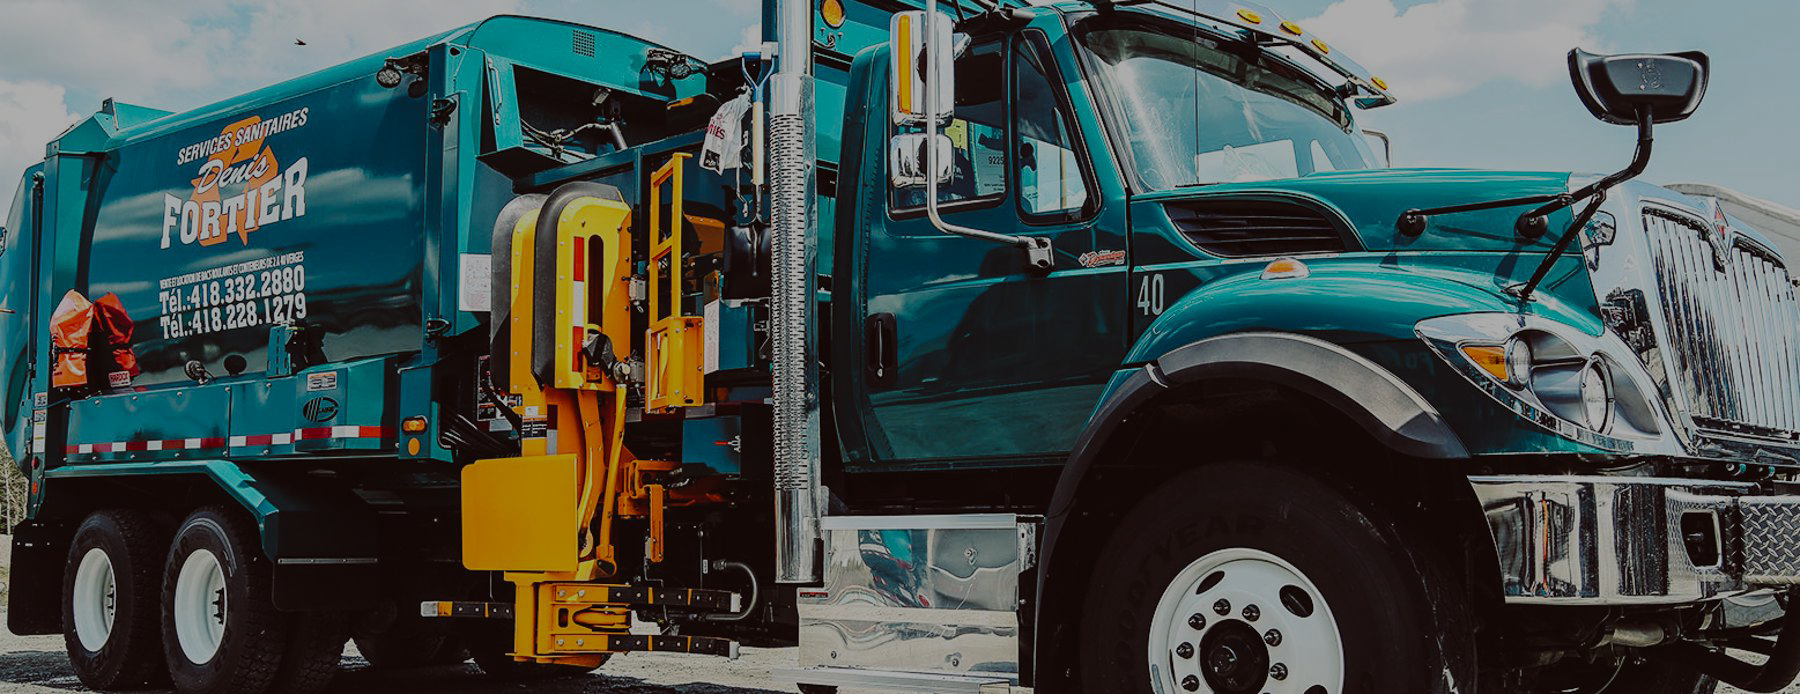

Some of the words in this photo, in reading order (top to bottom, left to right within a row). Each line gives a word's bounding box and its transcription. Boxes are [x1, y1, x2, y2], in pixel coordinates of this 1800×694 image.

[177, 132, 232, 165] SERVICES
[235, 107, 309, 146] SANITAIRES
[197, 154, 269, 194] Denis
[160, 156, 308, 250] FORTIER
[1137, 273, 1164, 316] 40
